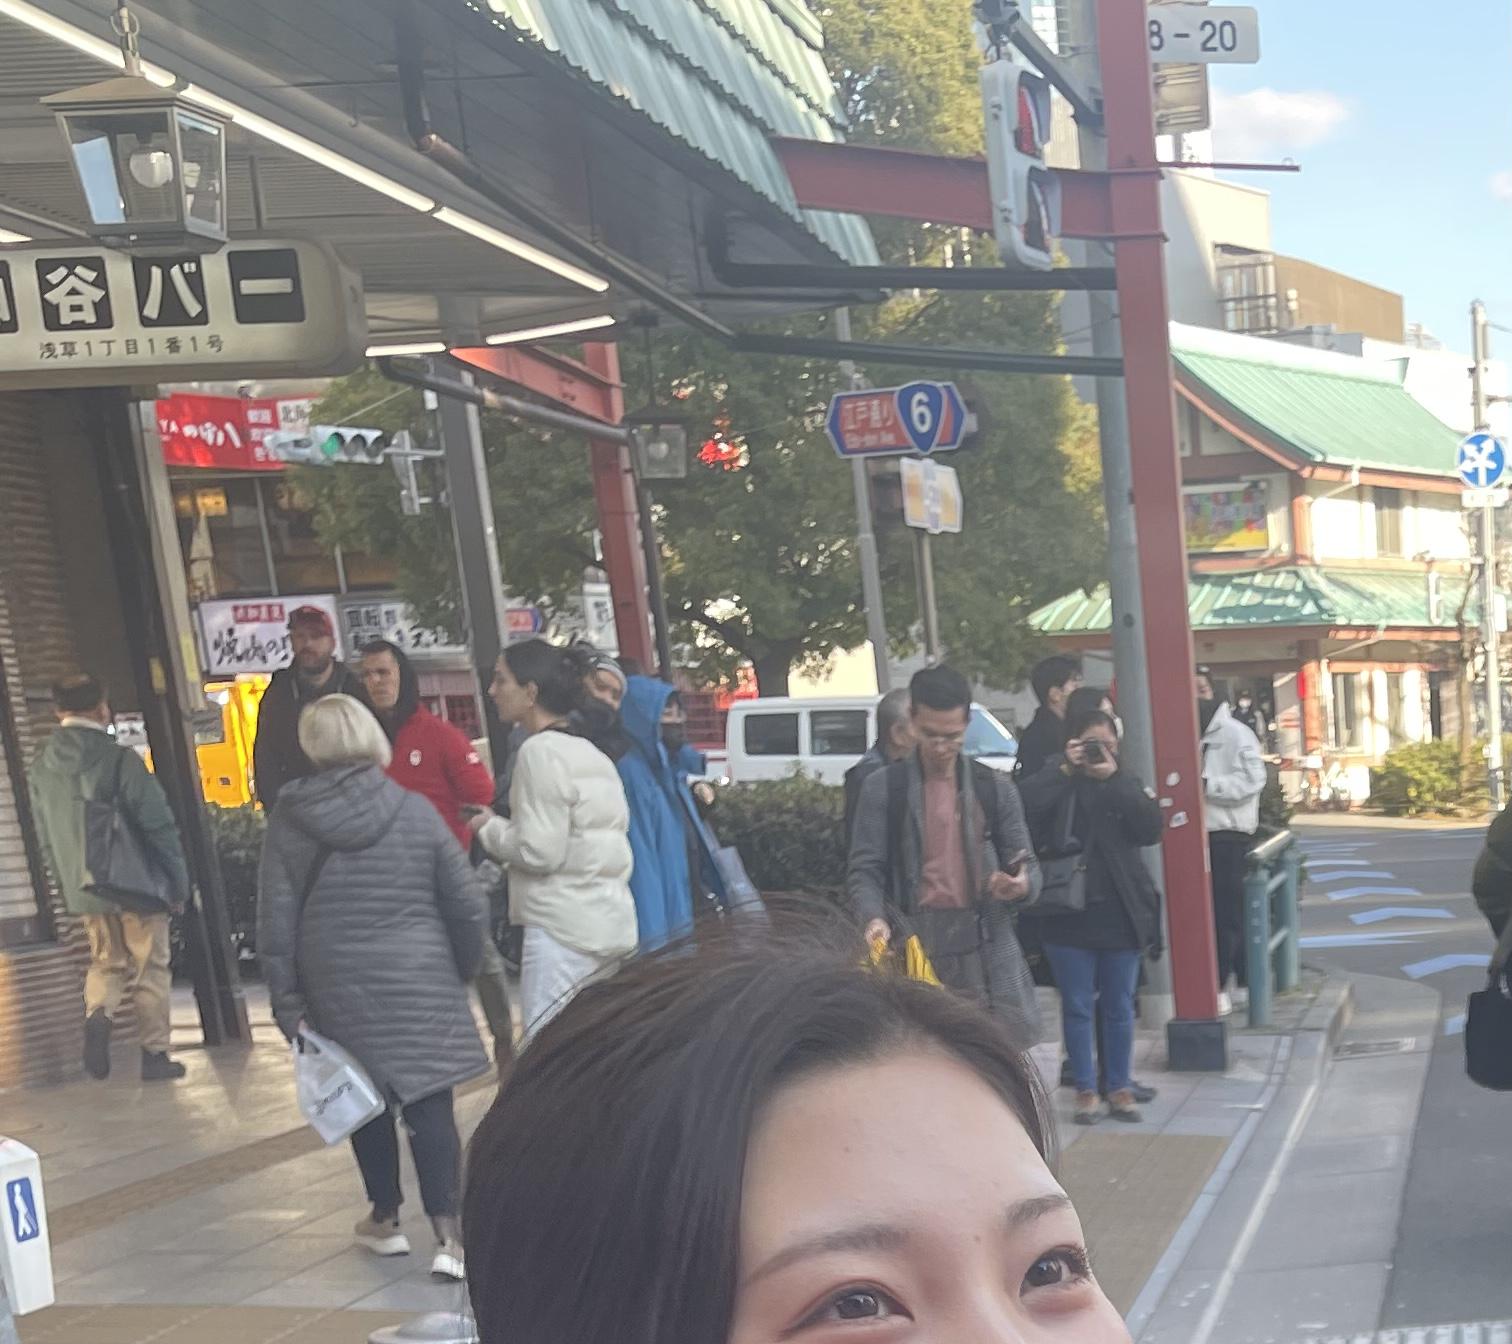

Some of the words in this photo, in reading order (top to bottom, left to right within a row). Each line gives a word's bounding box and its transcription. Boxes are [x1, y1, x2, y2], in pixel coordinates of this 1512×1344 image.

[0, 261, 294, 323] 谷バー
[39, 334, 224, 360] 浅草1丁目1番1号
[911, 391, 932, 434] 6
